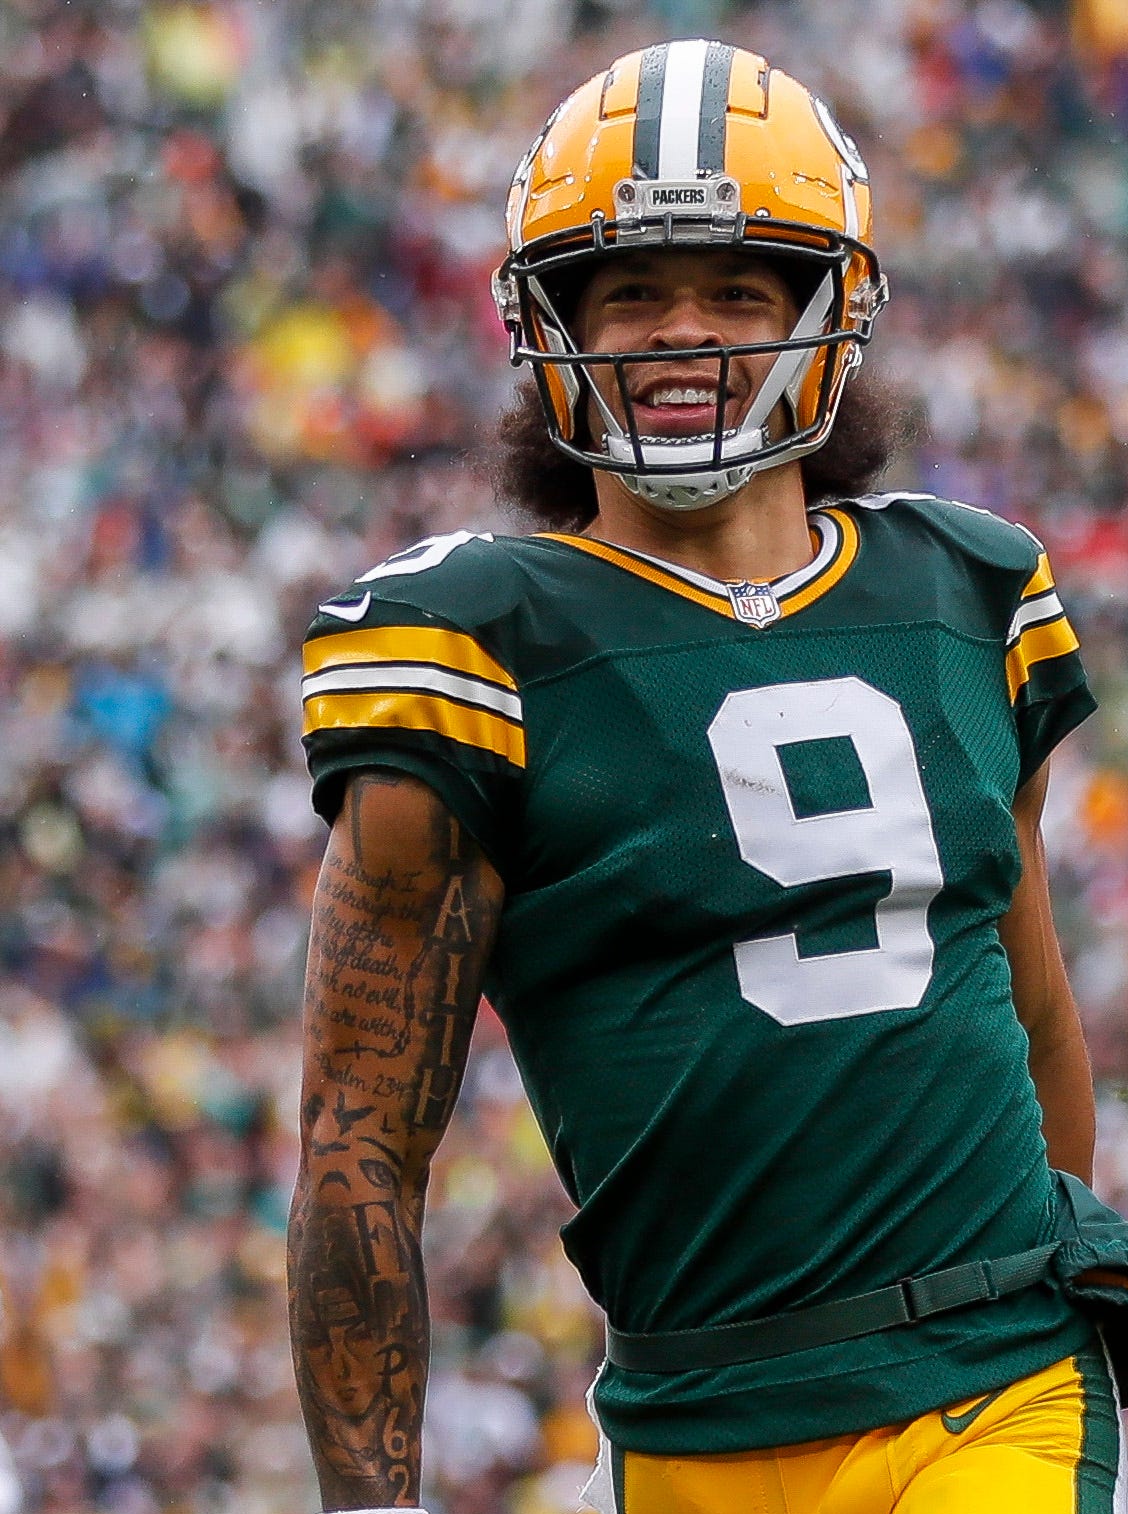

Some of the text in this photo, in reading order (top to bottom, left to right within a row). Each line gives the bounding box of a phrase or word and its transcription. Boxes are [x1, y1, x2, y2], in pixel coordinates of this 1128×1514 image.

[652, 188, 705, 206] PACKERS
[739, 597, 773, 618] NFL
[707, 675, 944, 1027] 9
